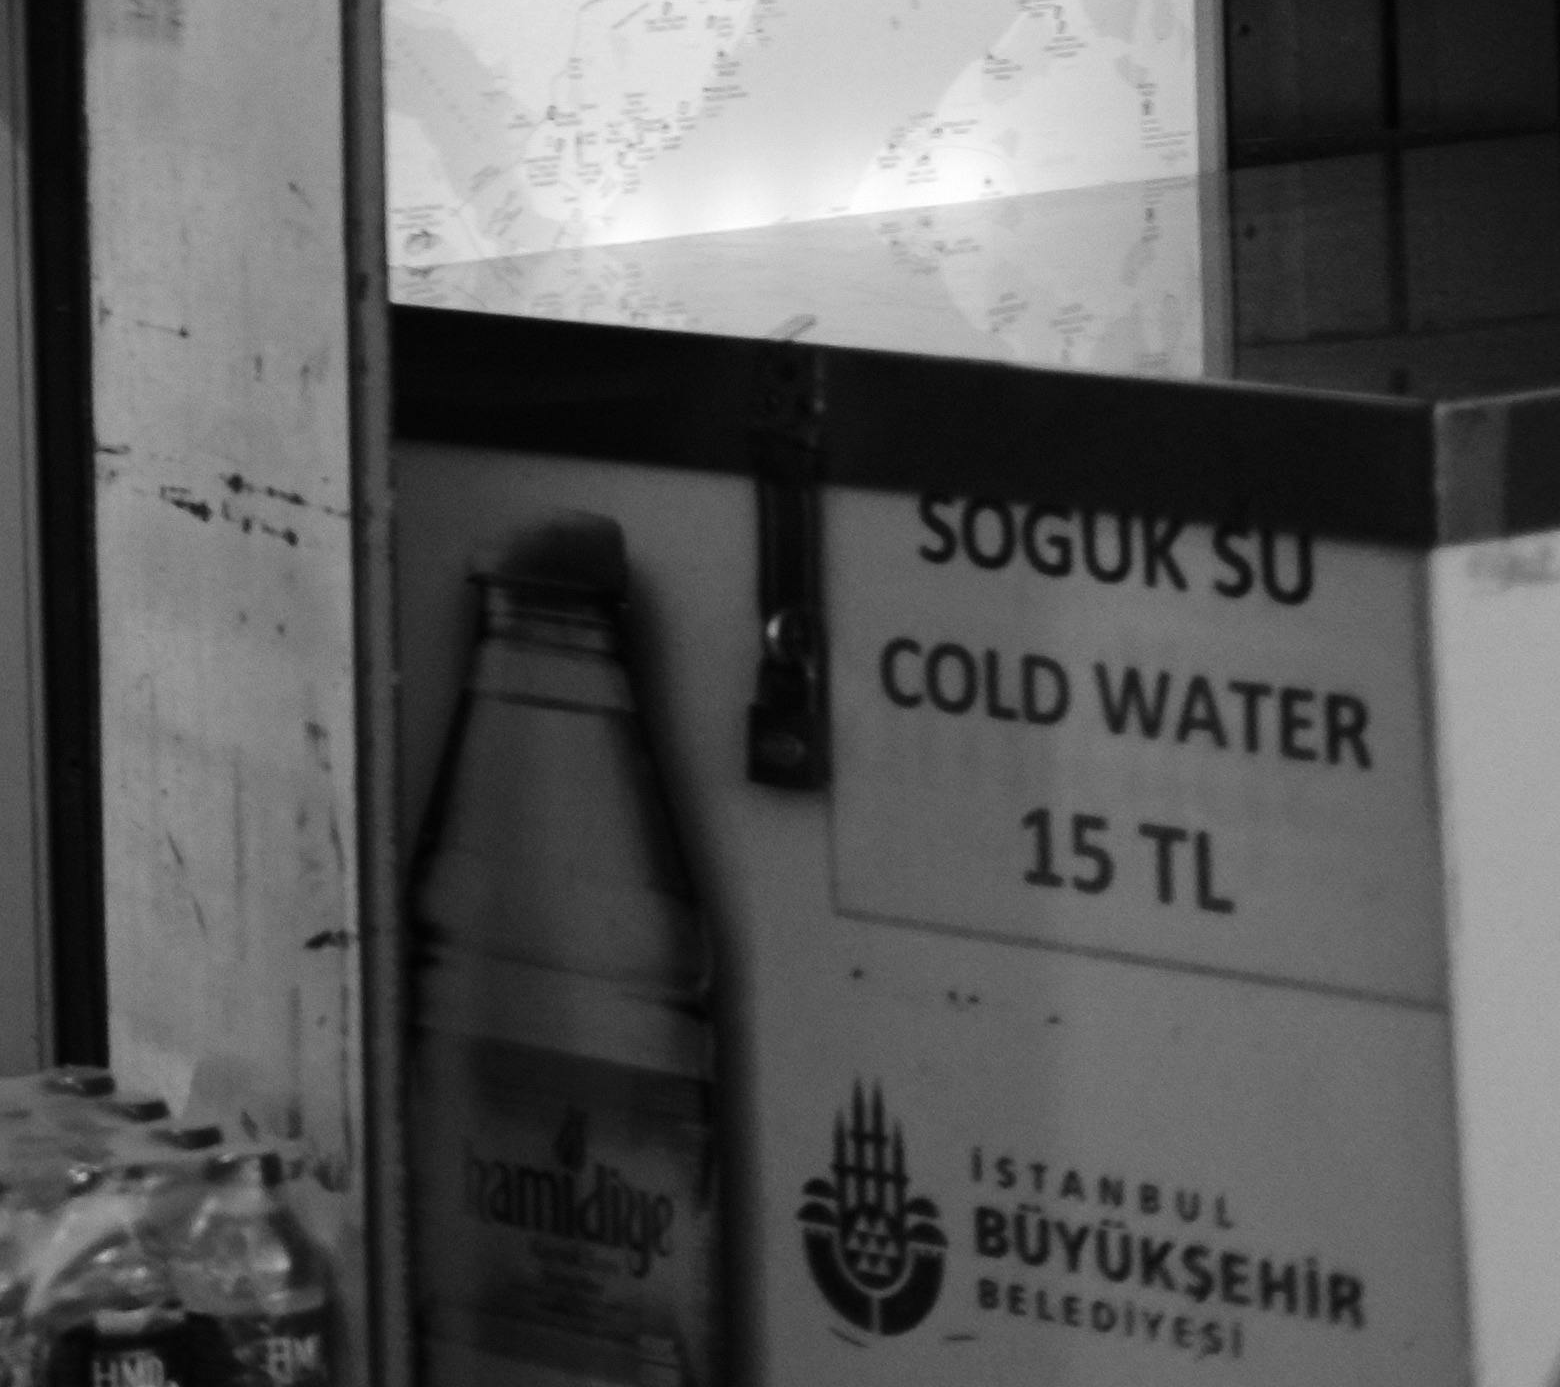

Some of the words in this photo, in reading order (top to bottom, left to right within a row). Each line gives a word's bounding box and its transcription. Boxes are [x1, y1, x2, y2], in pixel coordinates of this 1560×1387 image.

[1210, 529, 1318, 606] SU
[879, 636, 1074, 727] COLD
[1094, 661, 1374, 772] WATER
[1021, 805, 1116, 897] 15
[1139, 820, 1237, 916] TL
[970, 1146, 1237, 1230] İSTANBUL
[973, 1205, 1368, 1331] BÜYÜKŞEHİR
[978, 1277, 1245, 1360] BELEDİYESİ
